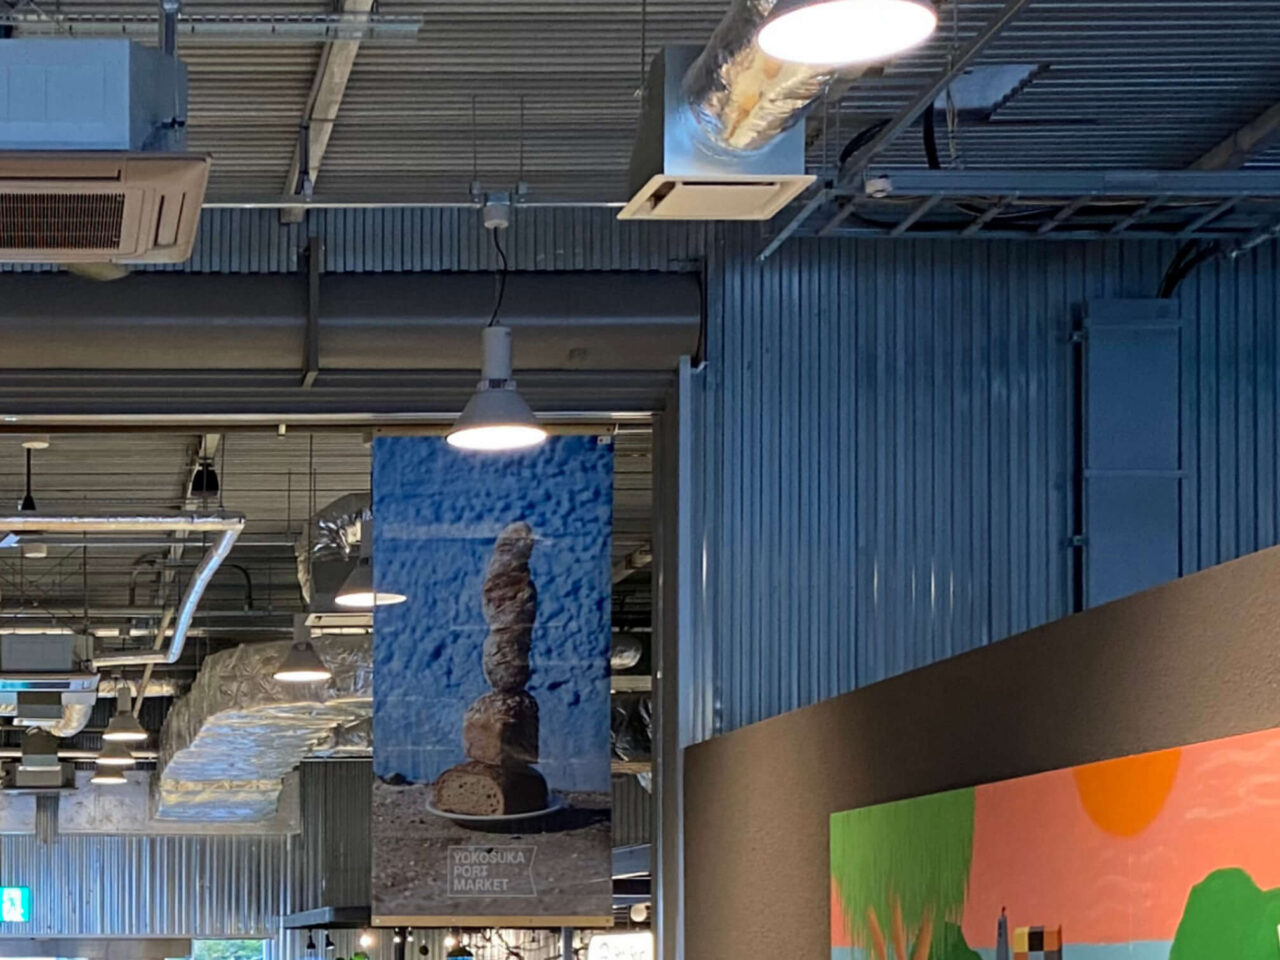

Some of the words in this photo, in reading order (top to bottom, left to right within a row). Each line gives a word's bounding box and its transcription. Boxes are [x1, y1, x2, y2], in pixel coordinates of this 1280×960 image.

[452, 850, 525, 864] YOKOSUKA
[453, 865, 489, 878] PORT
[453, 879, 509, 891] MARKET
